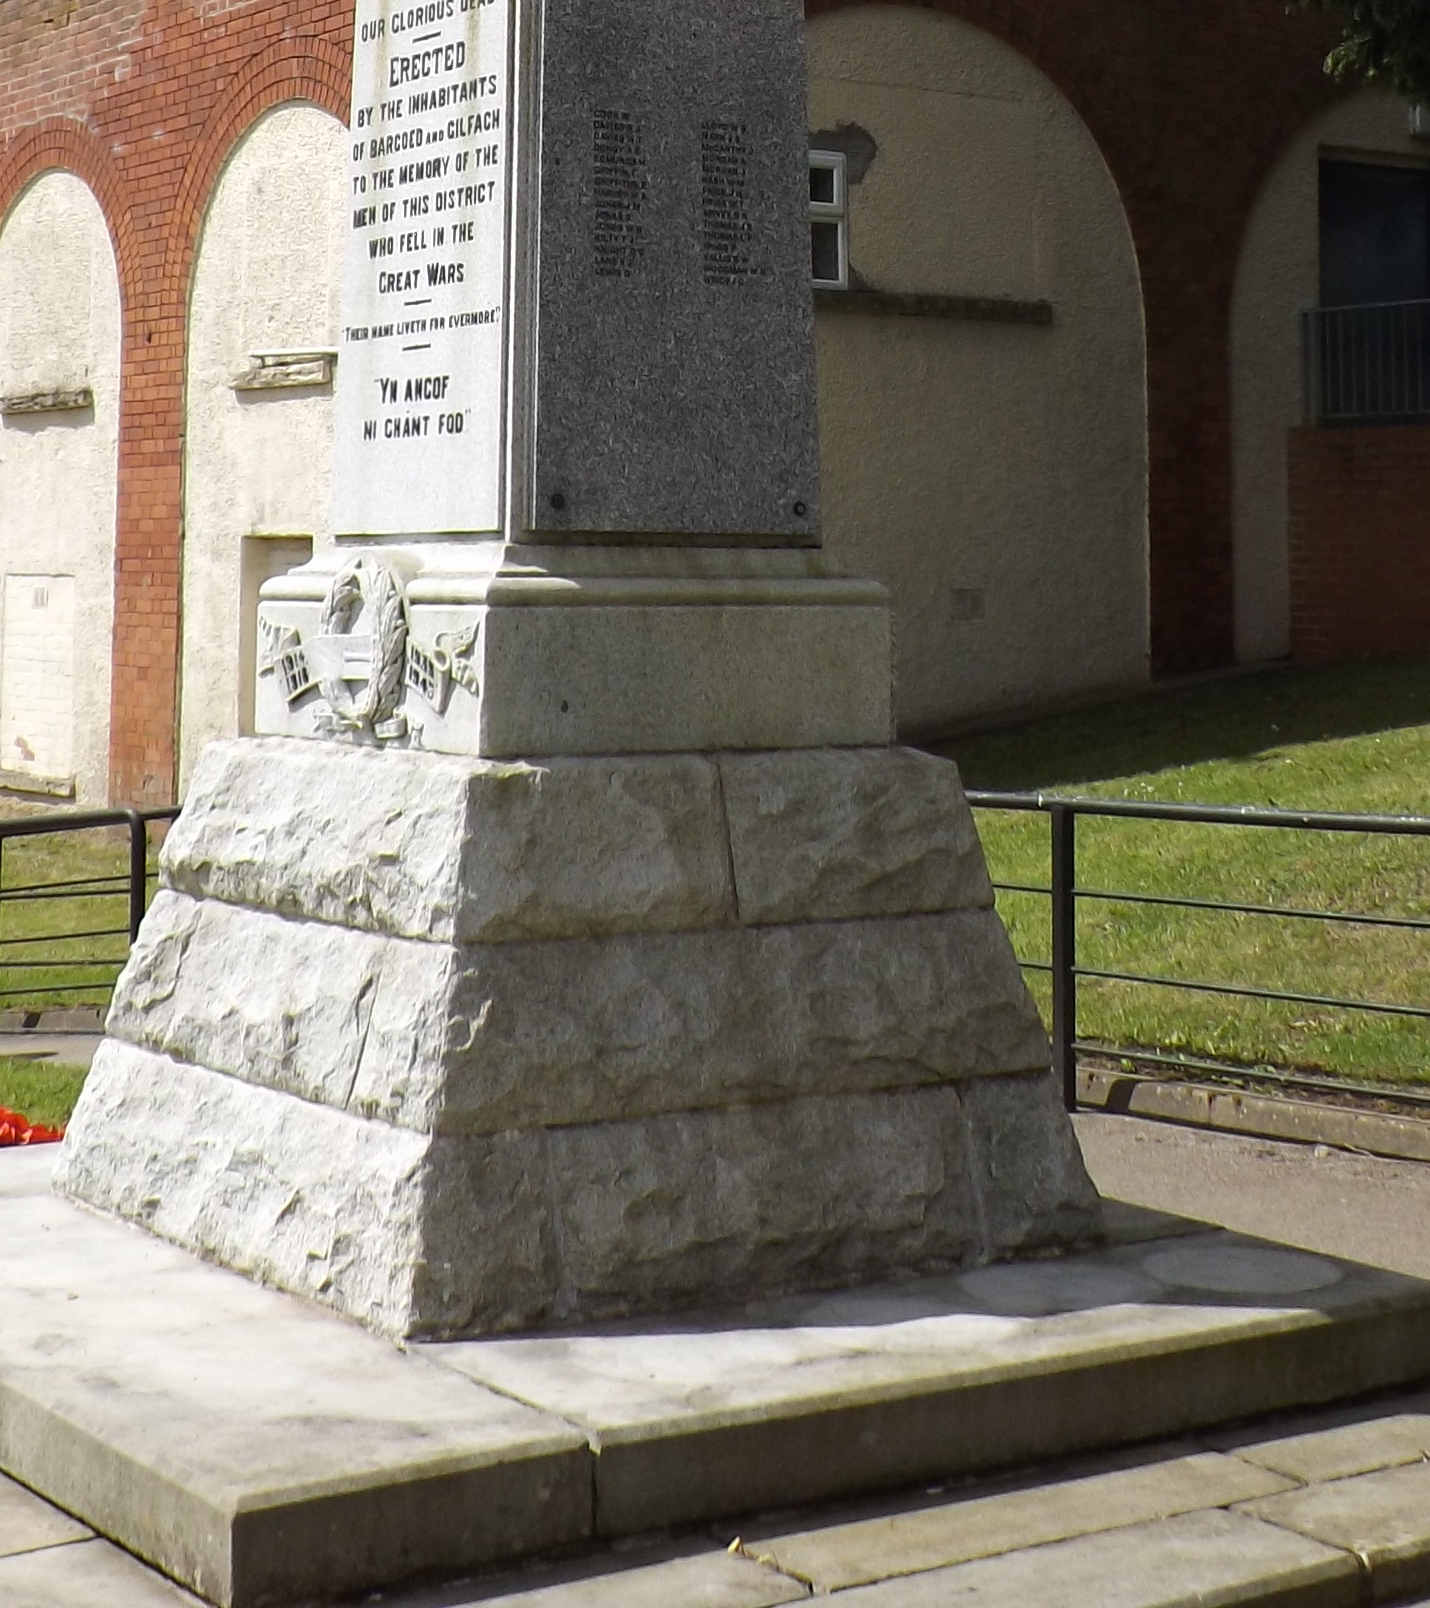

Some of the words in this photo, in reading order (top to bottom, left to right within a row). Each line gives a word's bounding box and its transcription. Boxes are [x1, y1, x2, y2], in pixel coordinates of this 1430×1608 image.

[361, 18, 385, 42] OUR
[389, 41, 466, 88] ERECTED
[357, 106, 373, 128] BY
[380, 100, 403, 123] THE
[408, 74, 498, 116] INHABITANTS
[352, 142, 365, 161] OF
[425, 129, 444, 145] AND
[352, 175, 367, 195] TO
[372, 168, 395, 191] THE
[399, 155, 450, 185] MEMORY
[455, 151, 469, 172] OF
[475, 144, 499, 168] THE
[353, 205, 377, 229] MEN
[382, 202, 396, 223] OF
[402, 194, 429, 219] THIS
[435, 181, 496, 212] DISTRICT
[368, 236, 395, 259] WHO
[399, 229, 427, 253] FELL
[432, 226, 445, 248] IN
[451, 221, 475, 244] THE
[426, 262, 465, 287] WARS
[371, 323, 395, 339] NAME
[396, 317, 427, 335] LIVETH
[429, 315, 446, 330] FOR
[363, 419, 377, 442] NI
[281, 650, 308, 677] 1914
